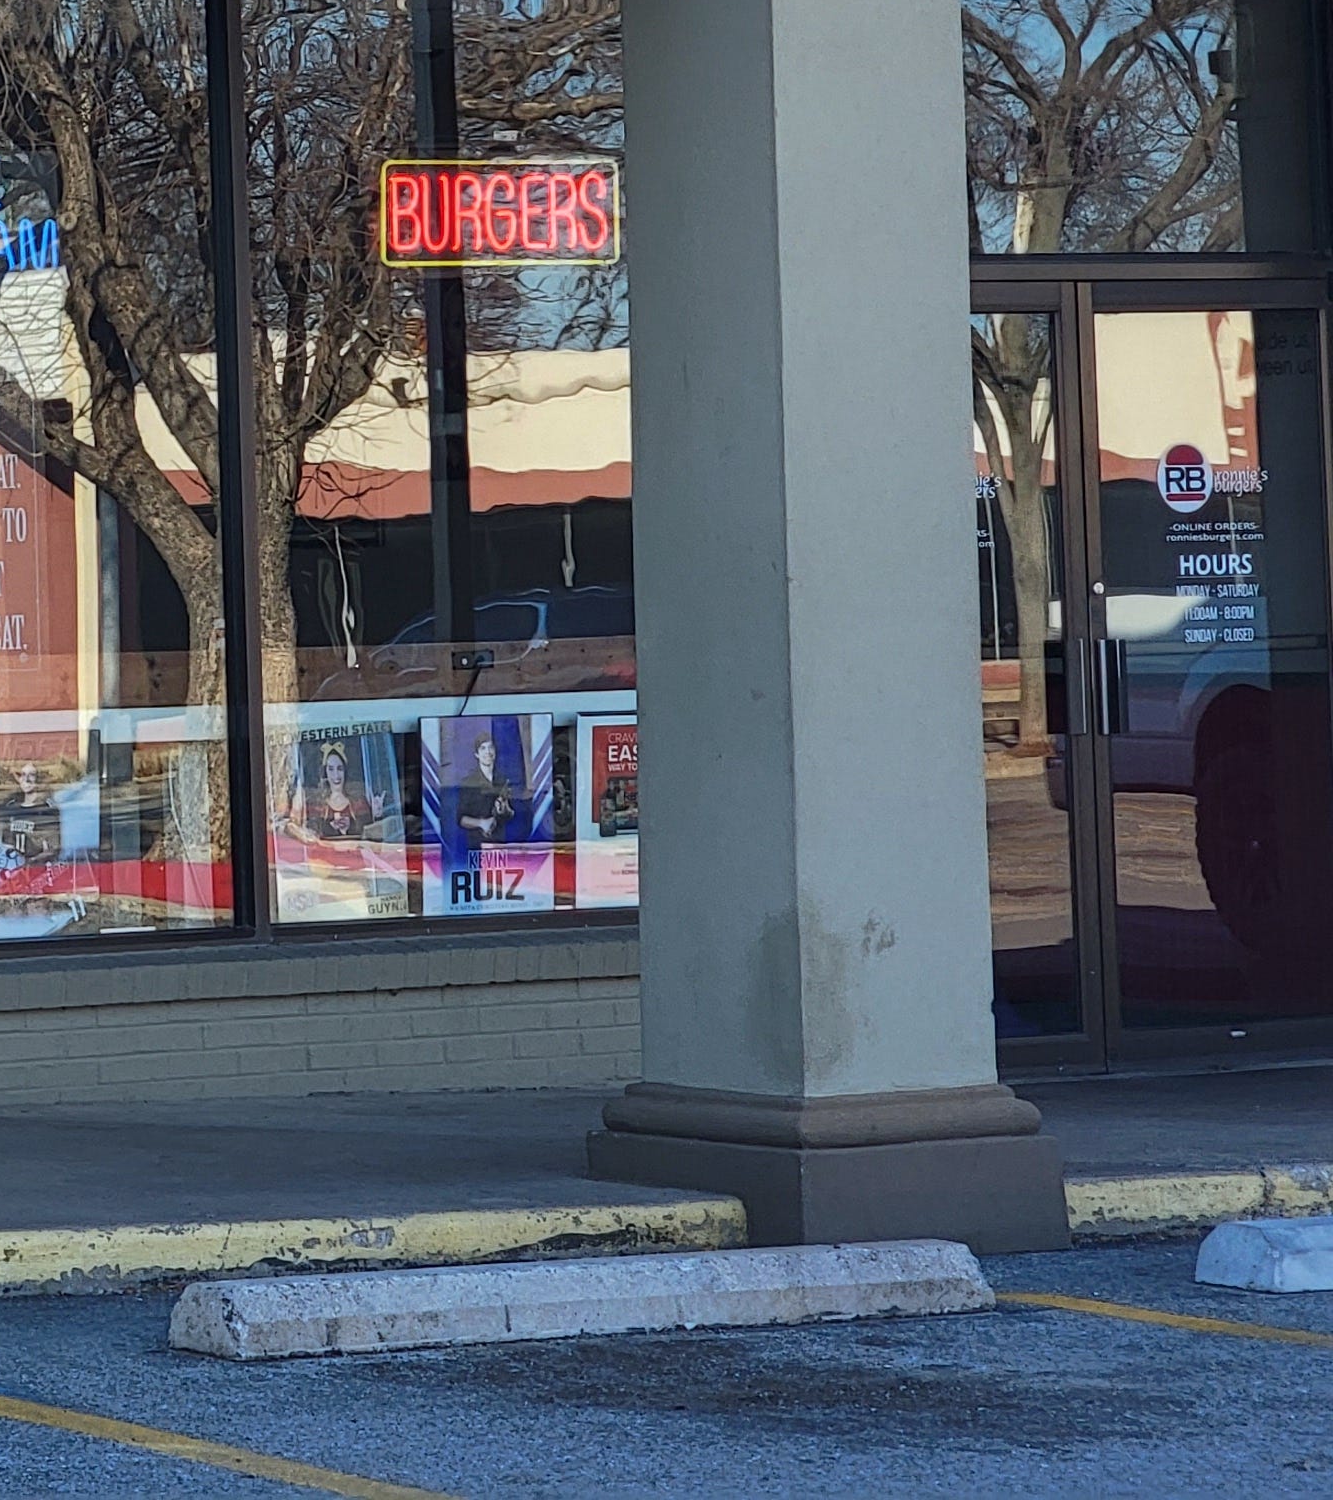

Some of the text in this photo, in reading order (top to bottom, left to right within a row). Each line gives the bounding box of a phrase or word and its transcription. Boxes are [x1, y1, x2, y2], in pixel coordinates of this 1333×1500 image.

[387, 171, 610, 253] BURGERS
[1164, 466, 1207, 493] RB
[1214, 465, 1269, 482] ronnie's
[1213, 474, 1263, 497] burgers
[2, 507, 28, 543] TO
[1165, 533, 1264, 543] ronniesburgers.com
[1179, 553, 1253, 576] HOURS
[1175, 585, 1211, 598] MONDAY
[1217, 583, 1260, 598] SATURDAY
[1184, 628, 1218, 643] SUNDAY
[1223, 627, 1255, 643] CLOSED
[468, 850, 508, 869] KEVIN
[451, 868, 525, 905] RUIZ
